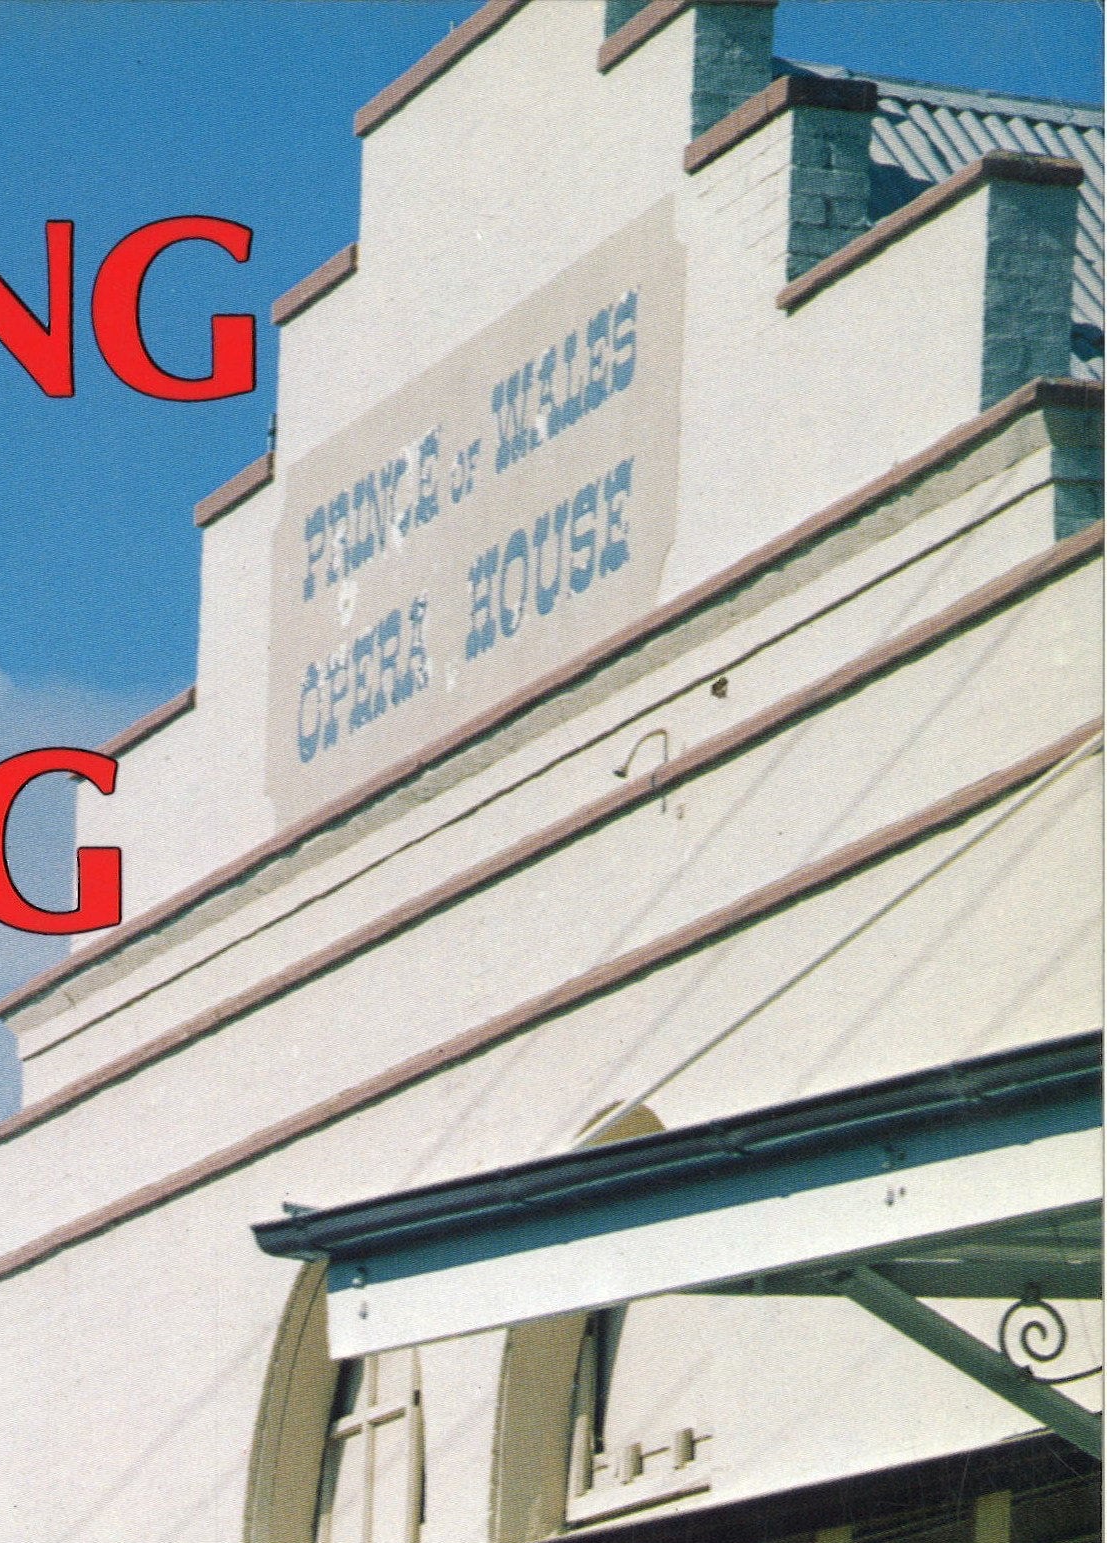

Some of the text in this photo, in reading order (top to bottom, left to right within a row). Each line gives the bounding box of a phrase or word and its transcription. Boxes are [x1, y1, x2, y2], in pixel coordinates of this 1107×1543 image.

[302, 424, 443, 603] PRINCE
[491, 285, 640, 475] WALES
[297, 456, 636, 764] OPERA HOUSE
